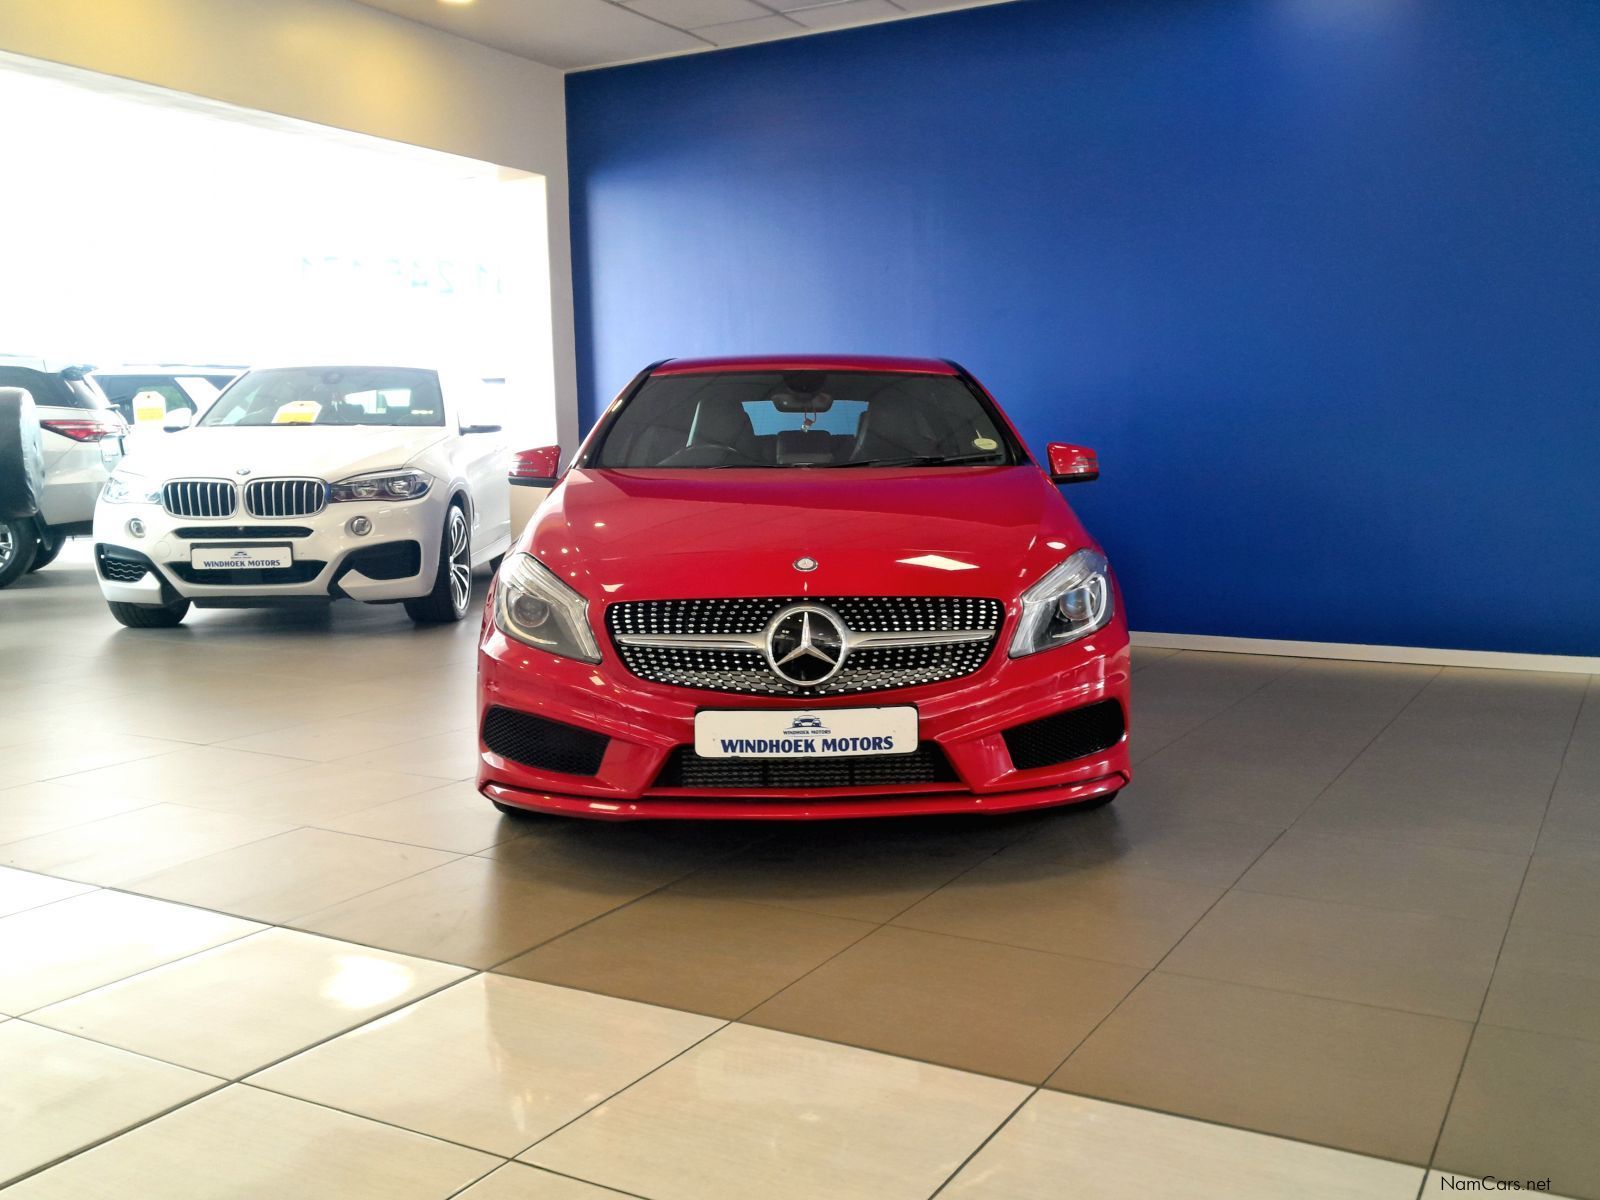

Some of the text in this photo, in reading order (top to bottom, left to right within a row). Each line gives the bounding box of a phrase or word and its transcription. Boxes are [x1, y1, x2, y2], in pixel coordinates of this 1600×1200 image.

[203, 559, 281, 568] WINDHOEK MOTORS
[720, 736, 894, 753] WINDHOEK MOTORS
